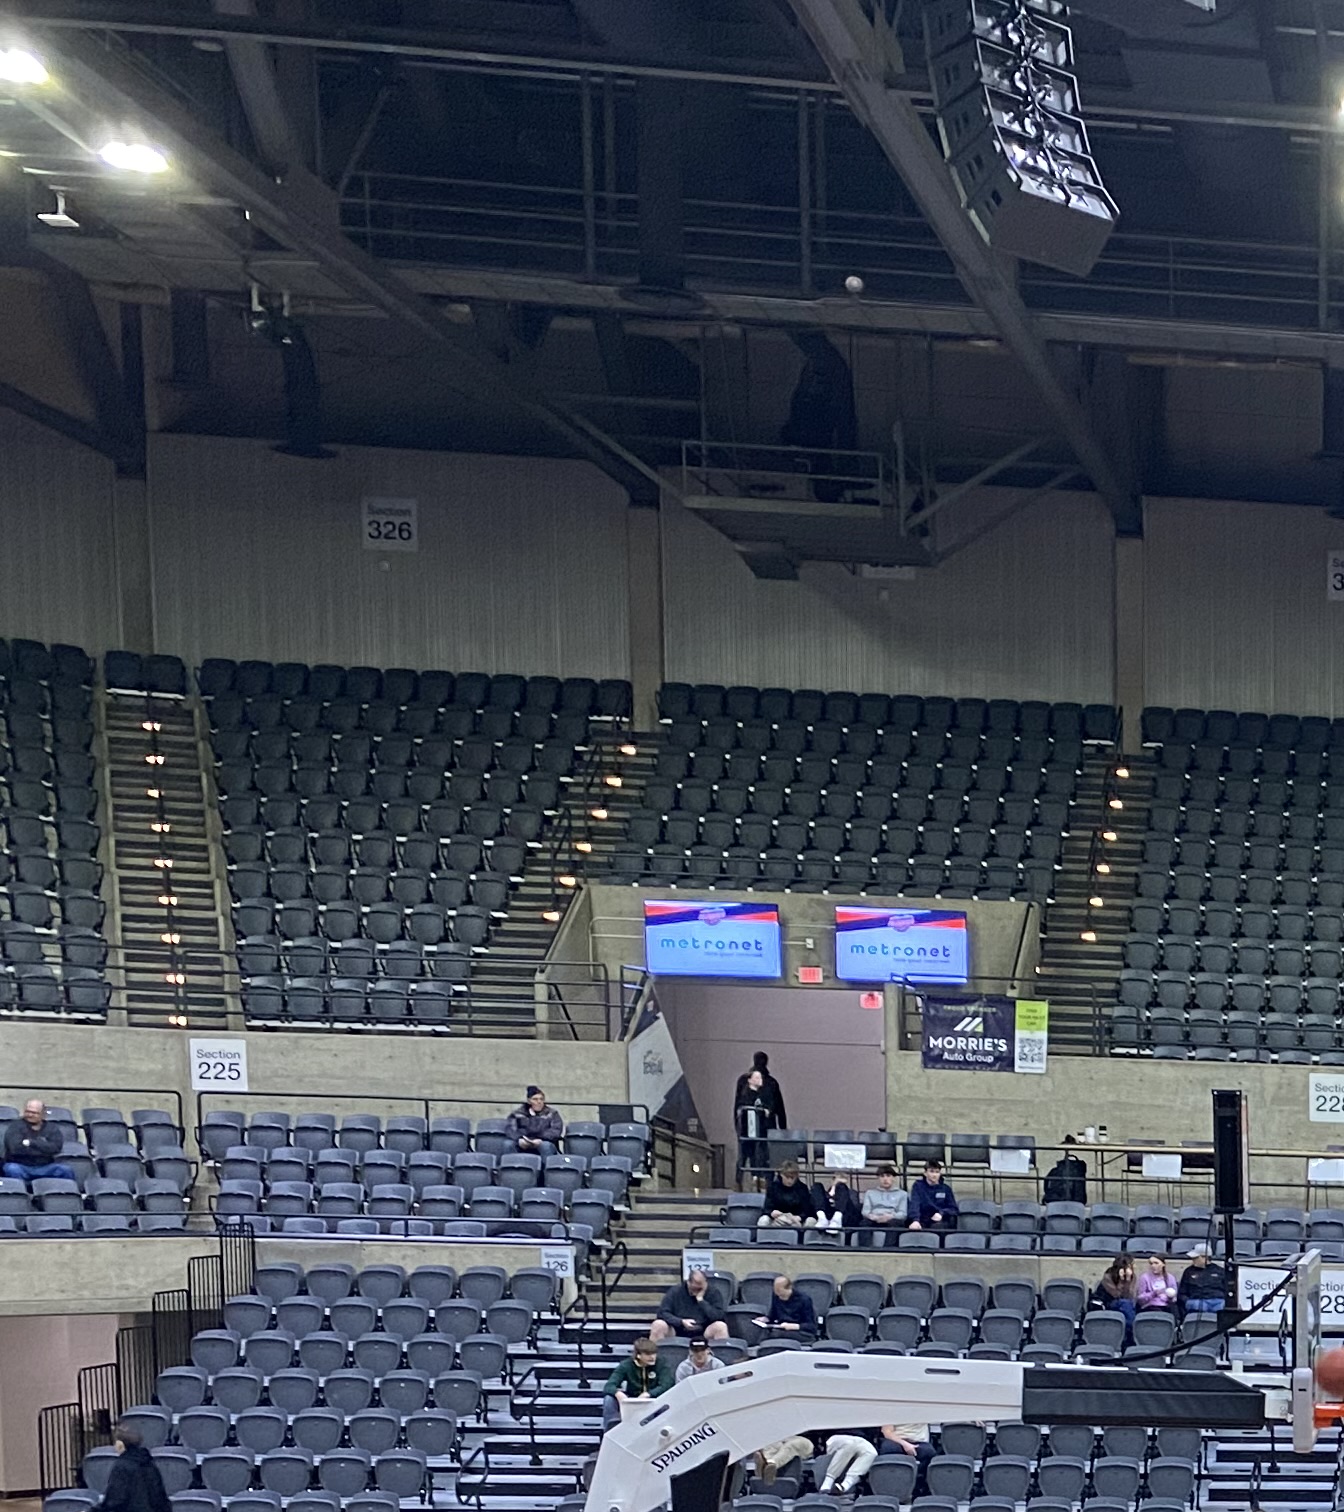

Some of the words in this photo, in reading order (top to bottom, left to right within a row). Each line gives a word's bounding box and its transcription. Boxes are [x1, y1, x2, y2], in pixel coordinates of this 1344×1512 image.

[368, 520, 412, 540] 326
[660, 936, 763, 951] metronet
[850, 942, 951, 957] metronet
[929, 1036, 1008, 1051] MORRIE'S
[196, 1049, 240, 1059] Section
[943, 1051, 965, 1060] Auto
[965, 1053, 994, 1063] Group
[199, 1061, 241, 1081] 225
[545, 1260, 568, 1271] 126
[1244, 1280, 1279, 1291] Secti
[651, 1422, 717, 1473] SPALDING
